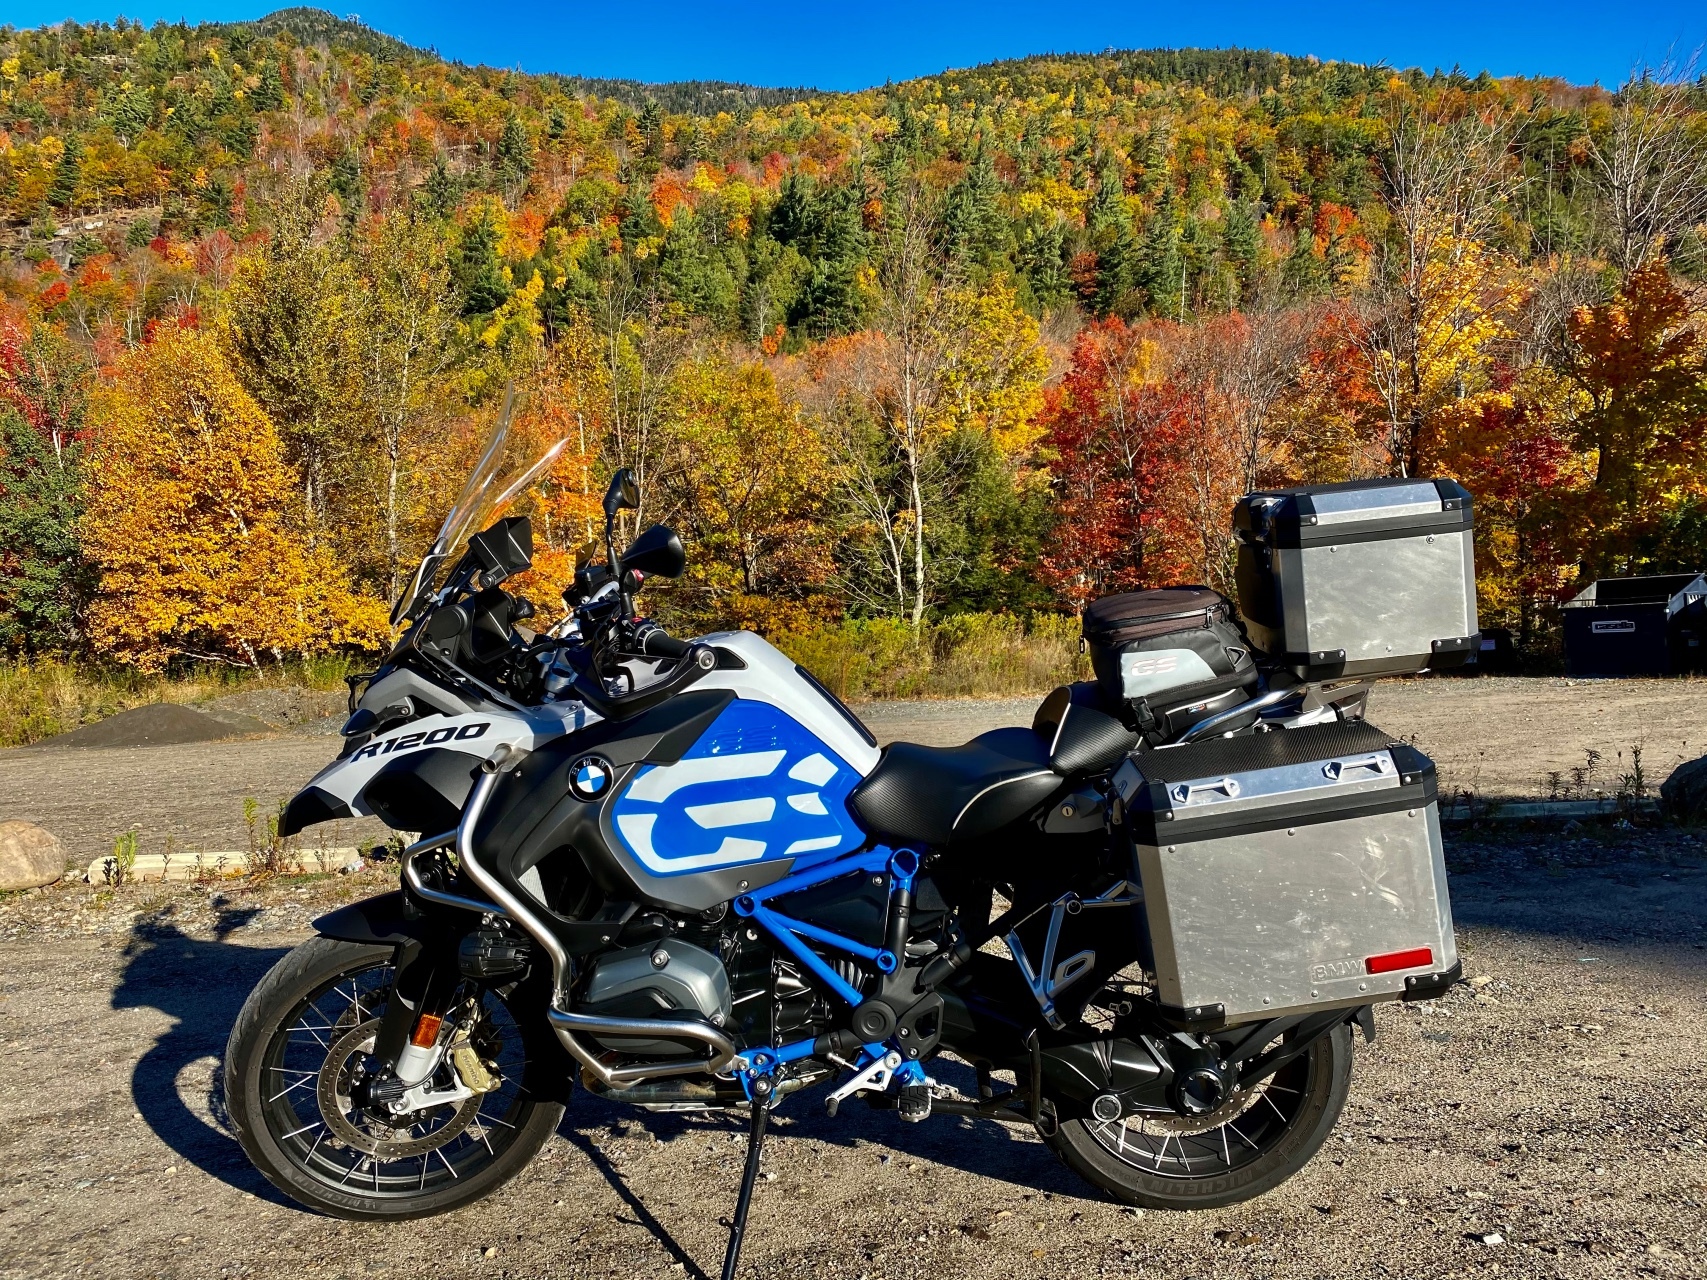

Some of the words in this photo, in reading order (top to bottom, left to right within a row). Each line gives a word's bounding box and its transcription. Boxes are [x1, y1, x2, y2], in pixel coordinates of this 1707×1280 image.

[1130, 655, 1178, 677] GS
[350, 722, 491, 763] R1200
[570, 757, 607, 776] BMW
[1312, 959, 1363, 981] BMW
[292, 1174, 360, 1208] MICHELIN
[1149, 1169, 1253, 1195] MICHELIN
